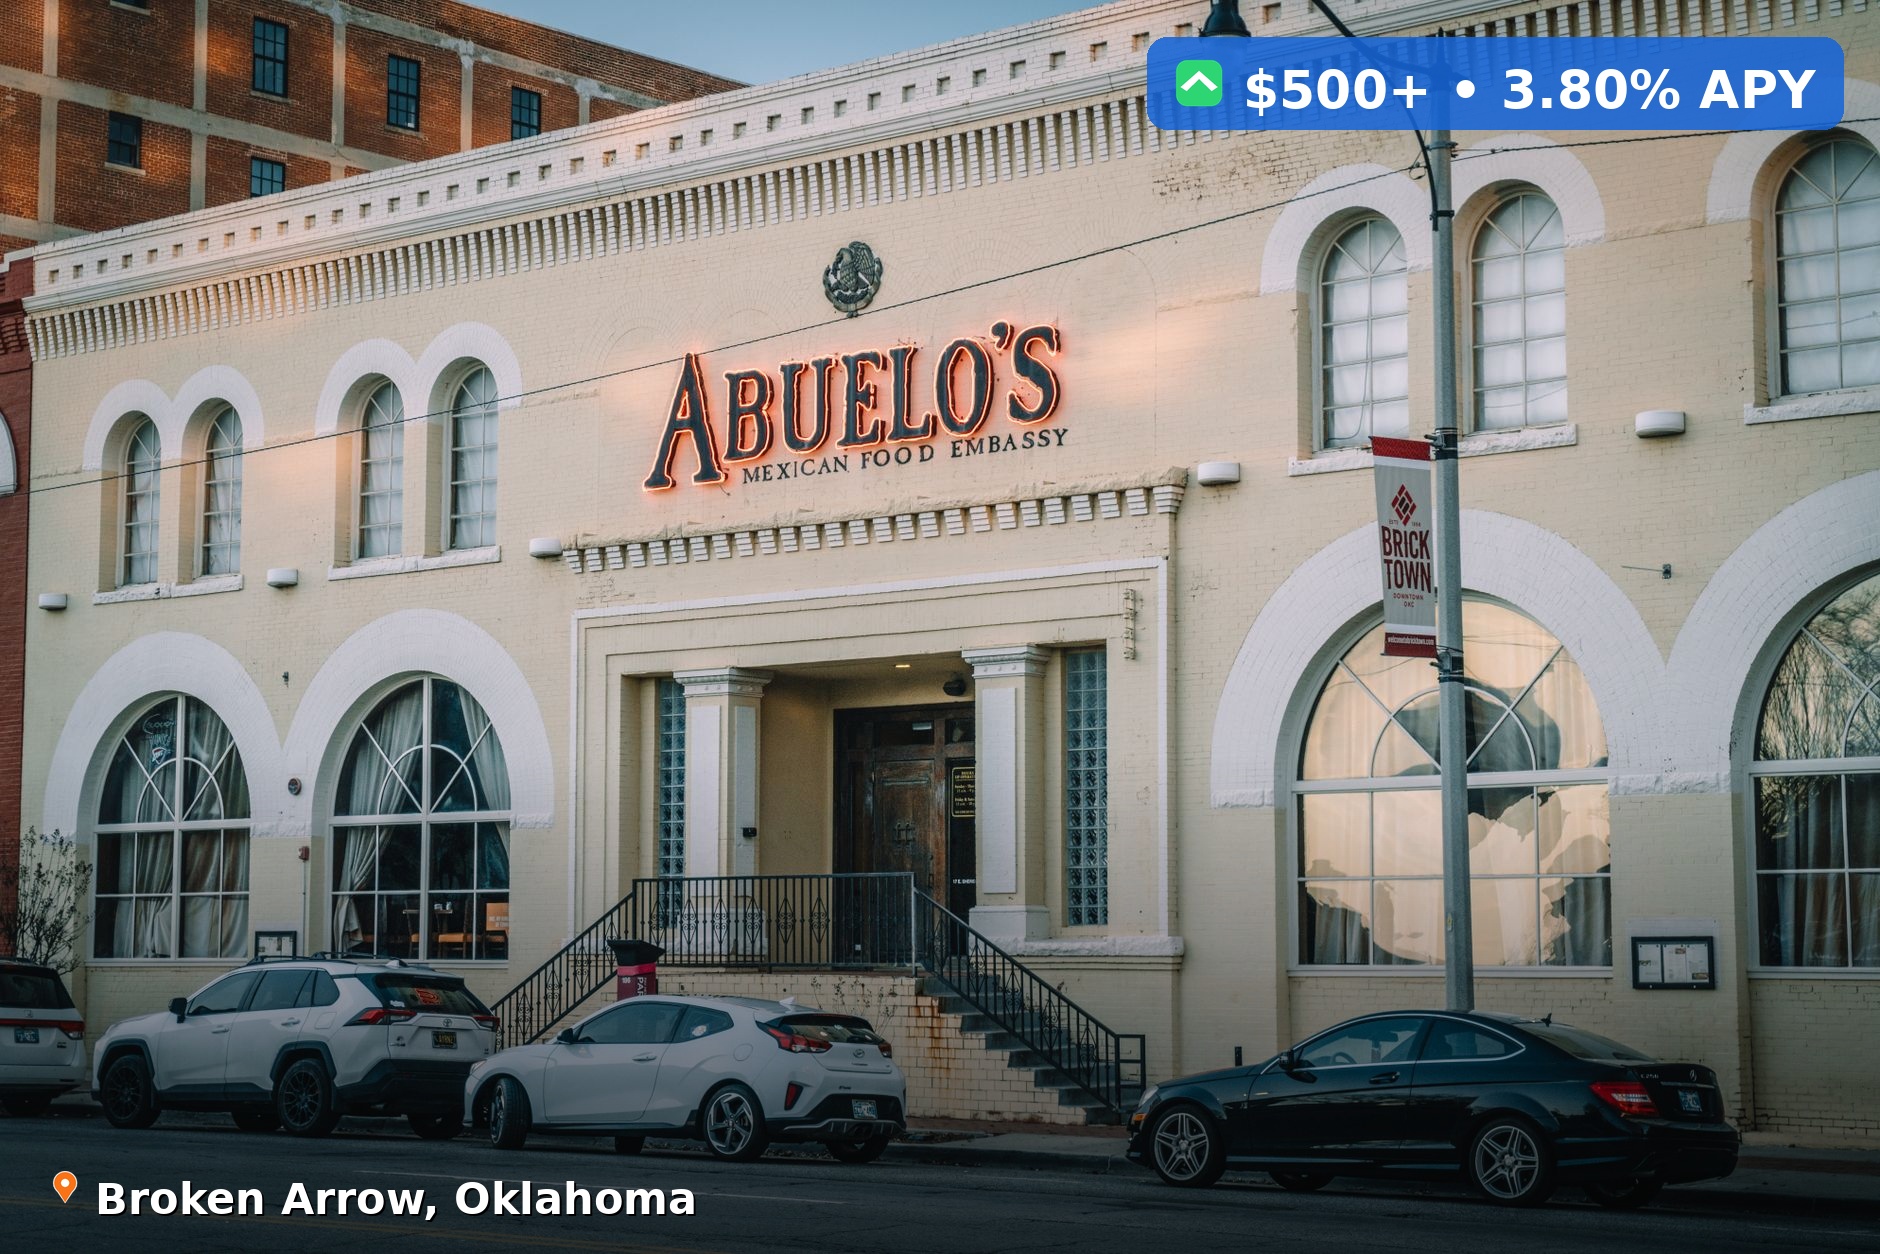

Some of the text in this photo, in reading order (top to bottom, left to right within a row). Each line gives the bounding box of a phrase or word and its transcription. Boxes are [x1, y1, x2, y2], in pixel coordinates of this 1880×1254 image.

[643, 319, 1061, 491] ABUELO'S
[742, 427, 1070, 485] MEXICAN FOOD EMBASSY
[1381, 525, 1431, 560] BRICK
[1383, 558, 1432, 594] TOWN
[1403, 600, 1415, 608] OKC
